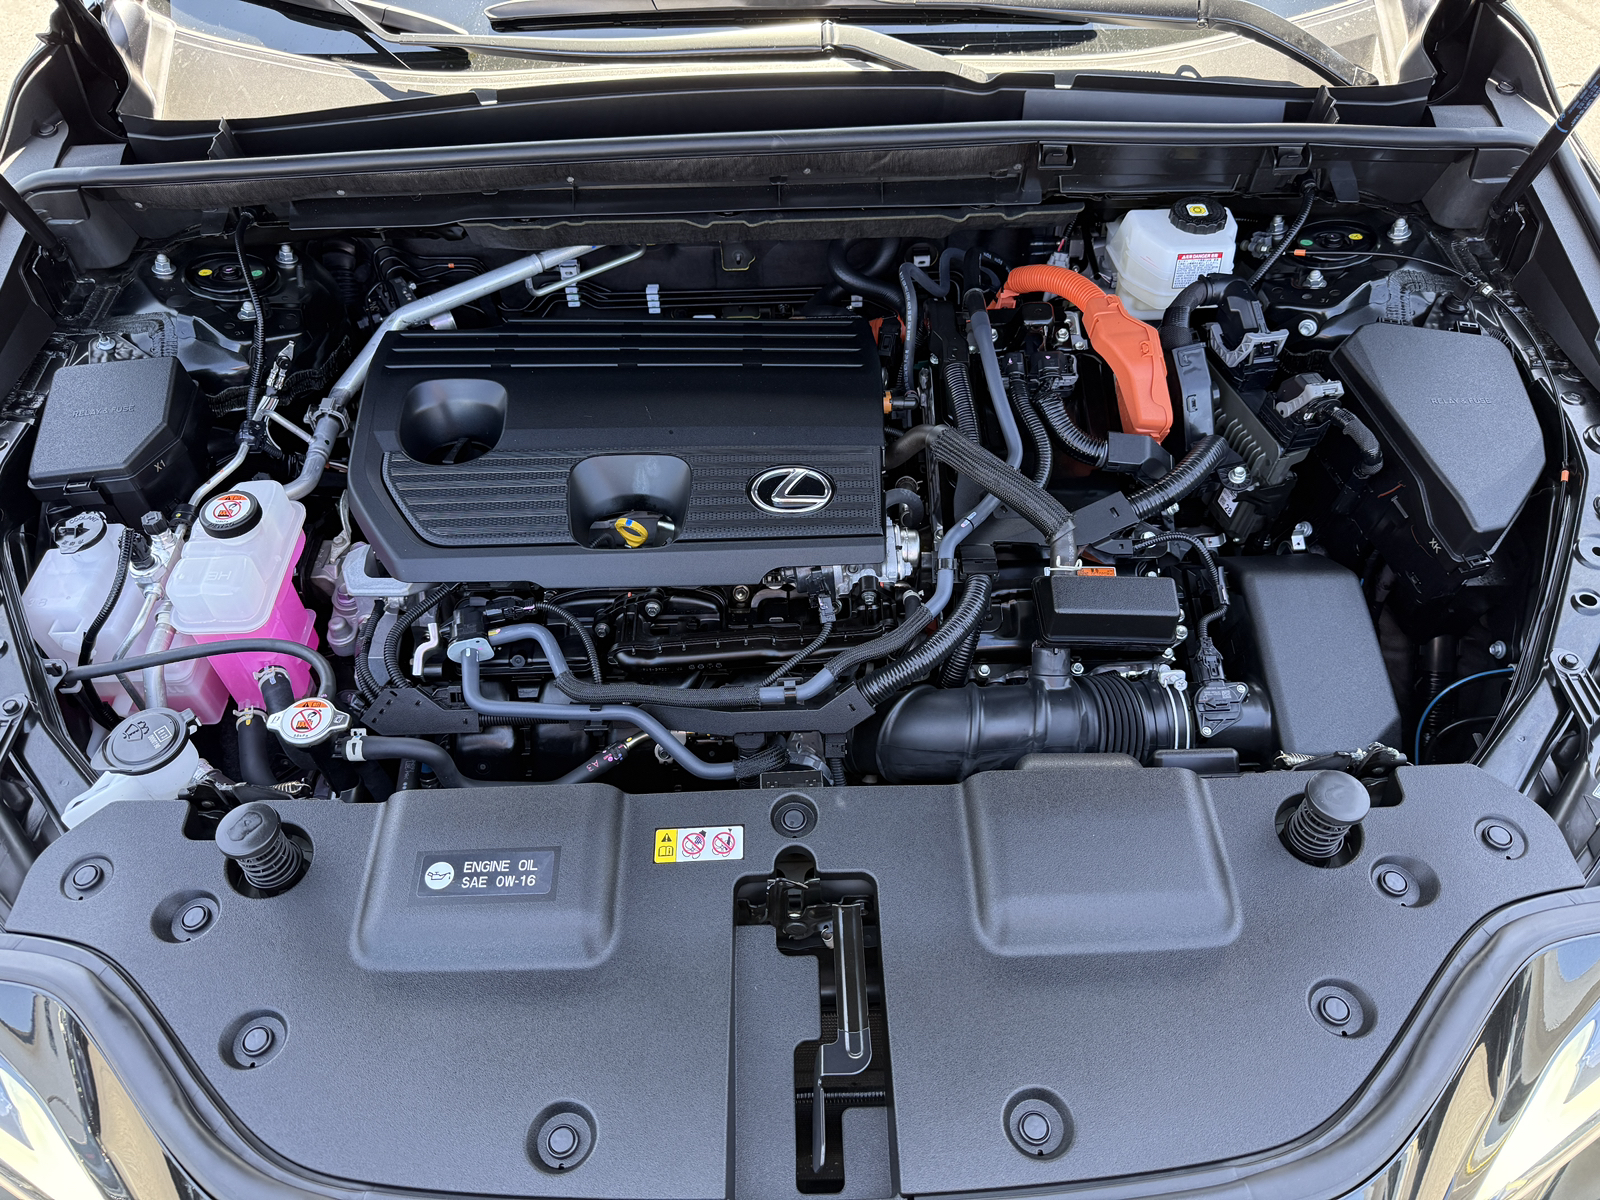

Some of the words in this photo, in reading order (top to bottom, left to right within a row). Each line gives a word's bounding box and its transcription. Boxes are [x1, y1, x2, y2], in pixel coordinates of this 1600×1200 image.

[1430, 397, 1459, 405] RELAY
[1468, 397, 1492, 405] FUSE
[72, 408, 101, 418] RELAY
[112, 404, 136, 414] FUSE
[153, 459, 167, 473] X1
[69, 515, 99, 525] COOLANT
[462, 860, 511, 874] ENGINE
[518, 859, 539, 872] OIL
[461, 875, 488, 889] SAE
[495, 874, 537, 888] 0W-16
